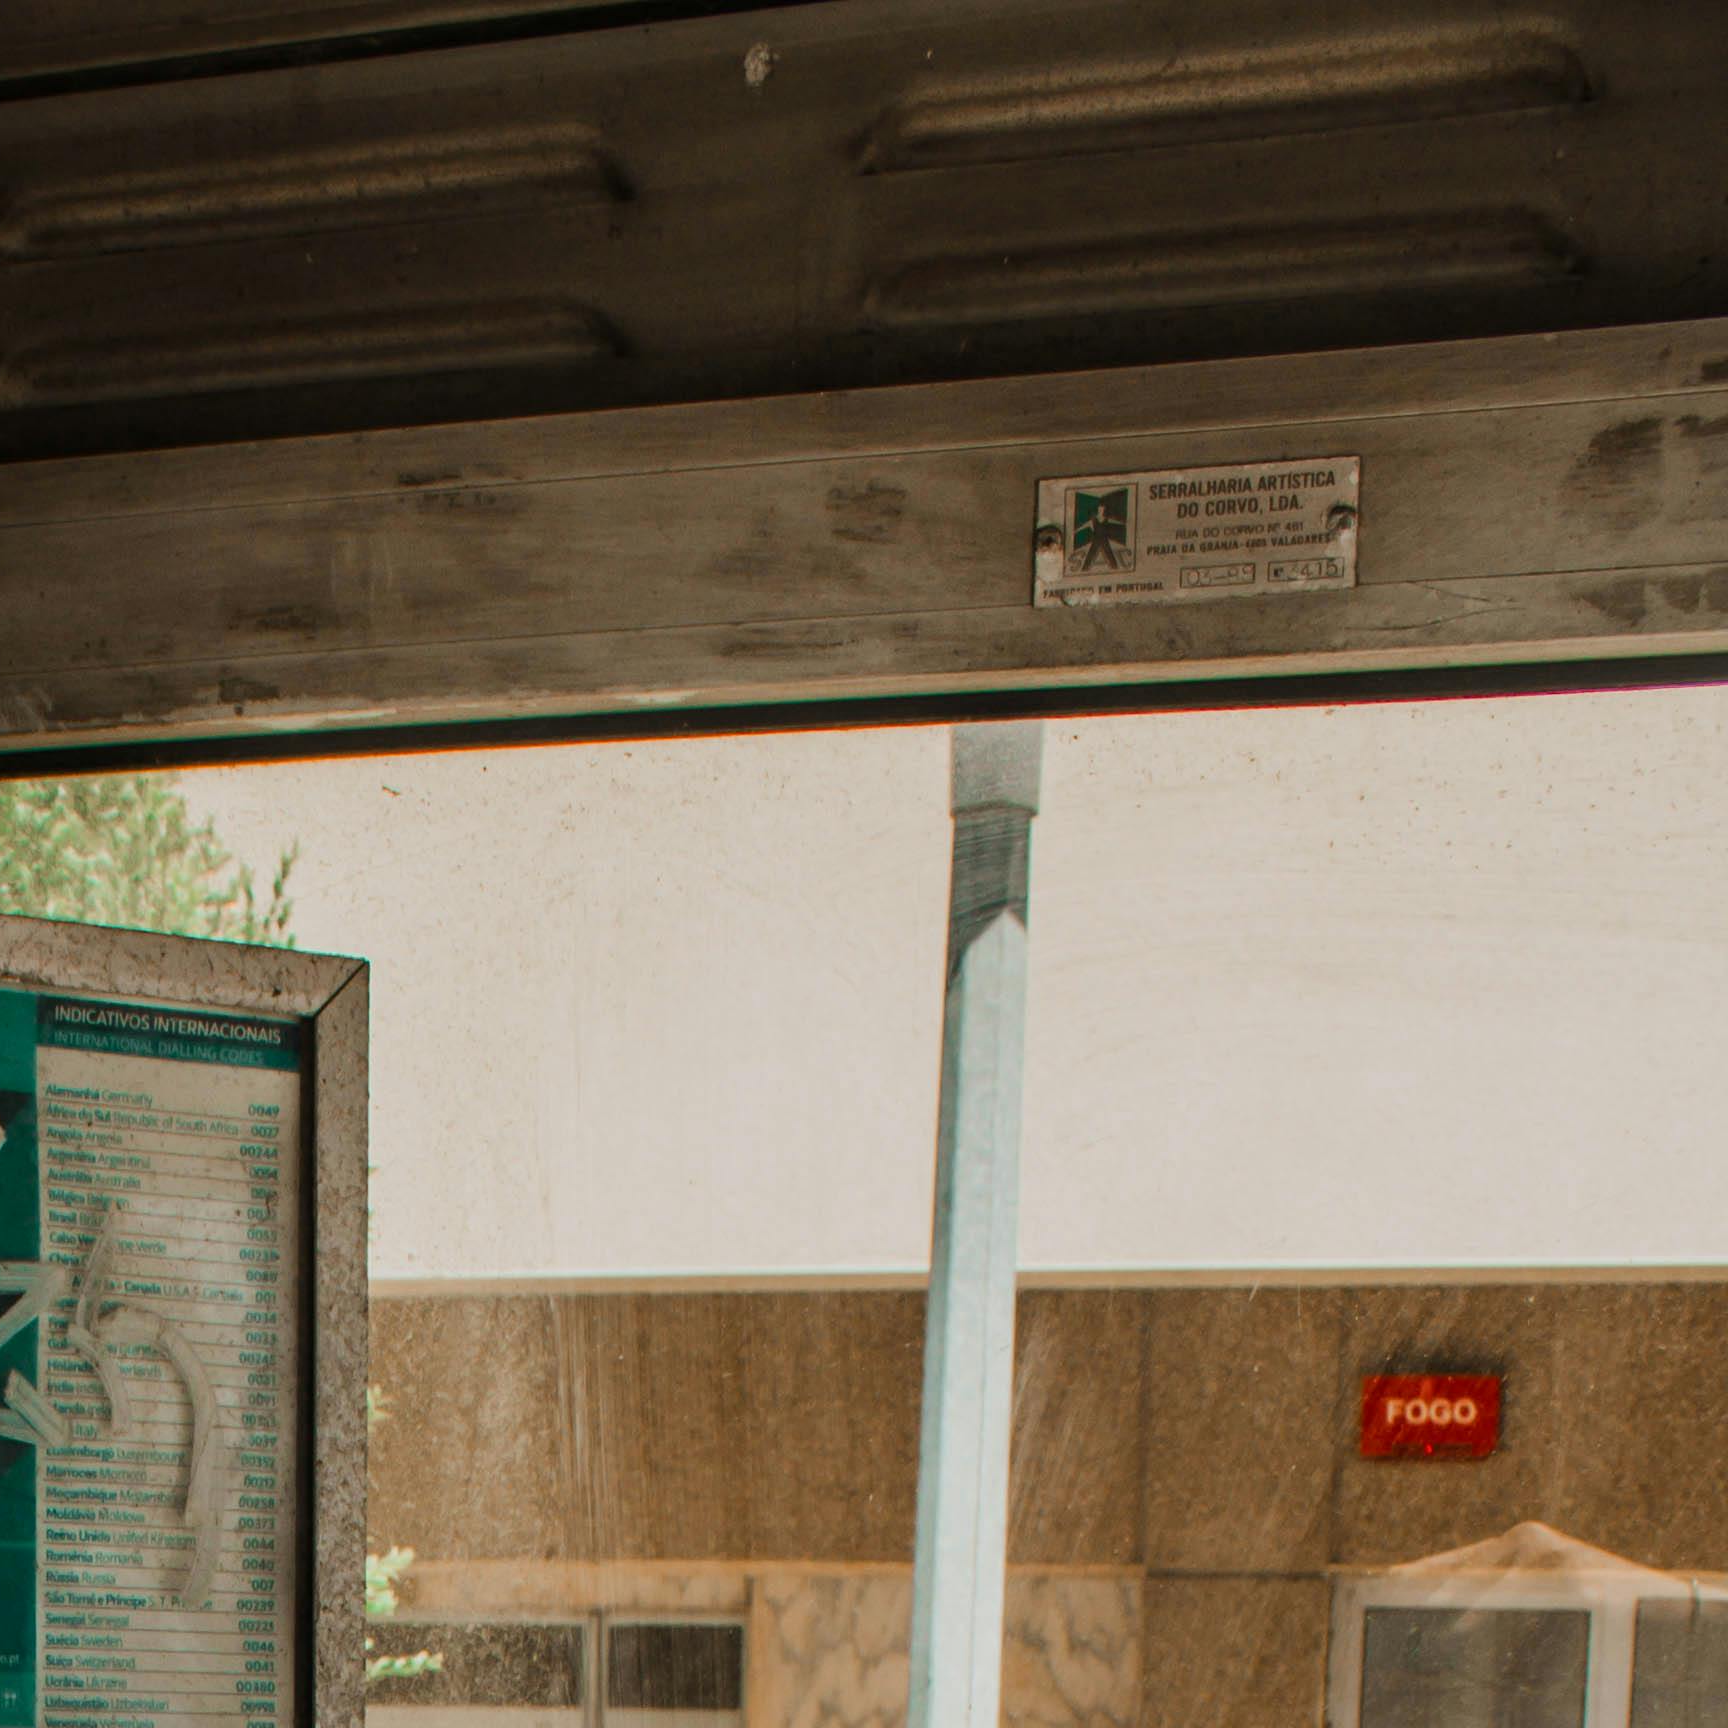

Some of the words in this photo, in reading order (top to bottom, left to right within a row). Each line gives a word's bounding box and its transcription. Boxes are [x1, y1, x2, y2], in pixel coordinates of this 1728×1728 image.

[1149, 477, 1252, 501] SERRALHARIA
[1257, 470, 1335, 492] ARTÍSTICA
[1177, 501, 1202, 519] DO
[1205, 498, 1264, 517] CORVO,
[1269, 494, 1304, 513] LDA.
[1175, 528, 1199, 541] RUA
[1202, 525, 1221, 539] DO
[1223, 524, 1264, 538] CORVO
[1146, 542, 1177, 556] PRAIA
[1180, 541, 1197, 554] DA
[1116, 580, 1165, 594] PORTUGAL
[55, 1005, 150, 1031] INDICATIVOS
[153, 1017, 281, 1044] INTERNACIONAIS
[54, 1031, 153, 1054] INTERNATIONAL
[158, 1040, 217, 1061] DIALLING
[219, 1048, 264, 1065] CODES
[1386, 1398, 1477, 1425] FOGO
